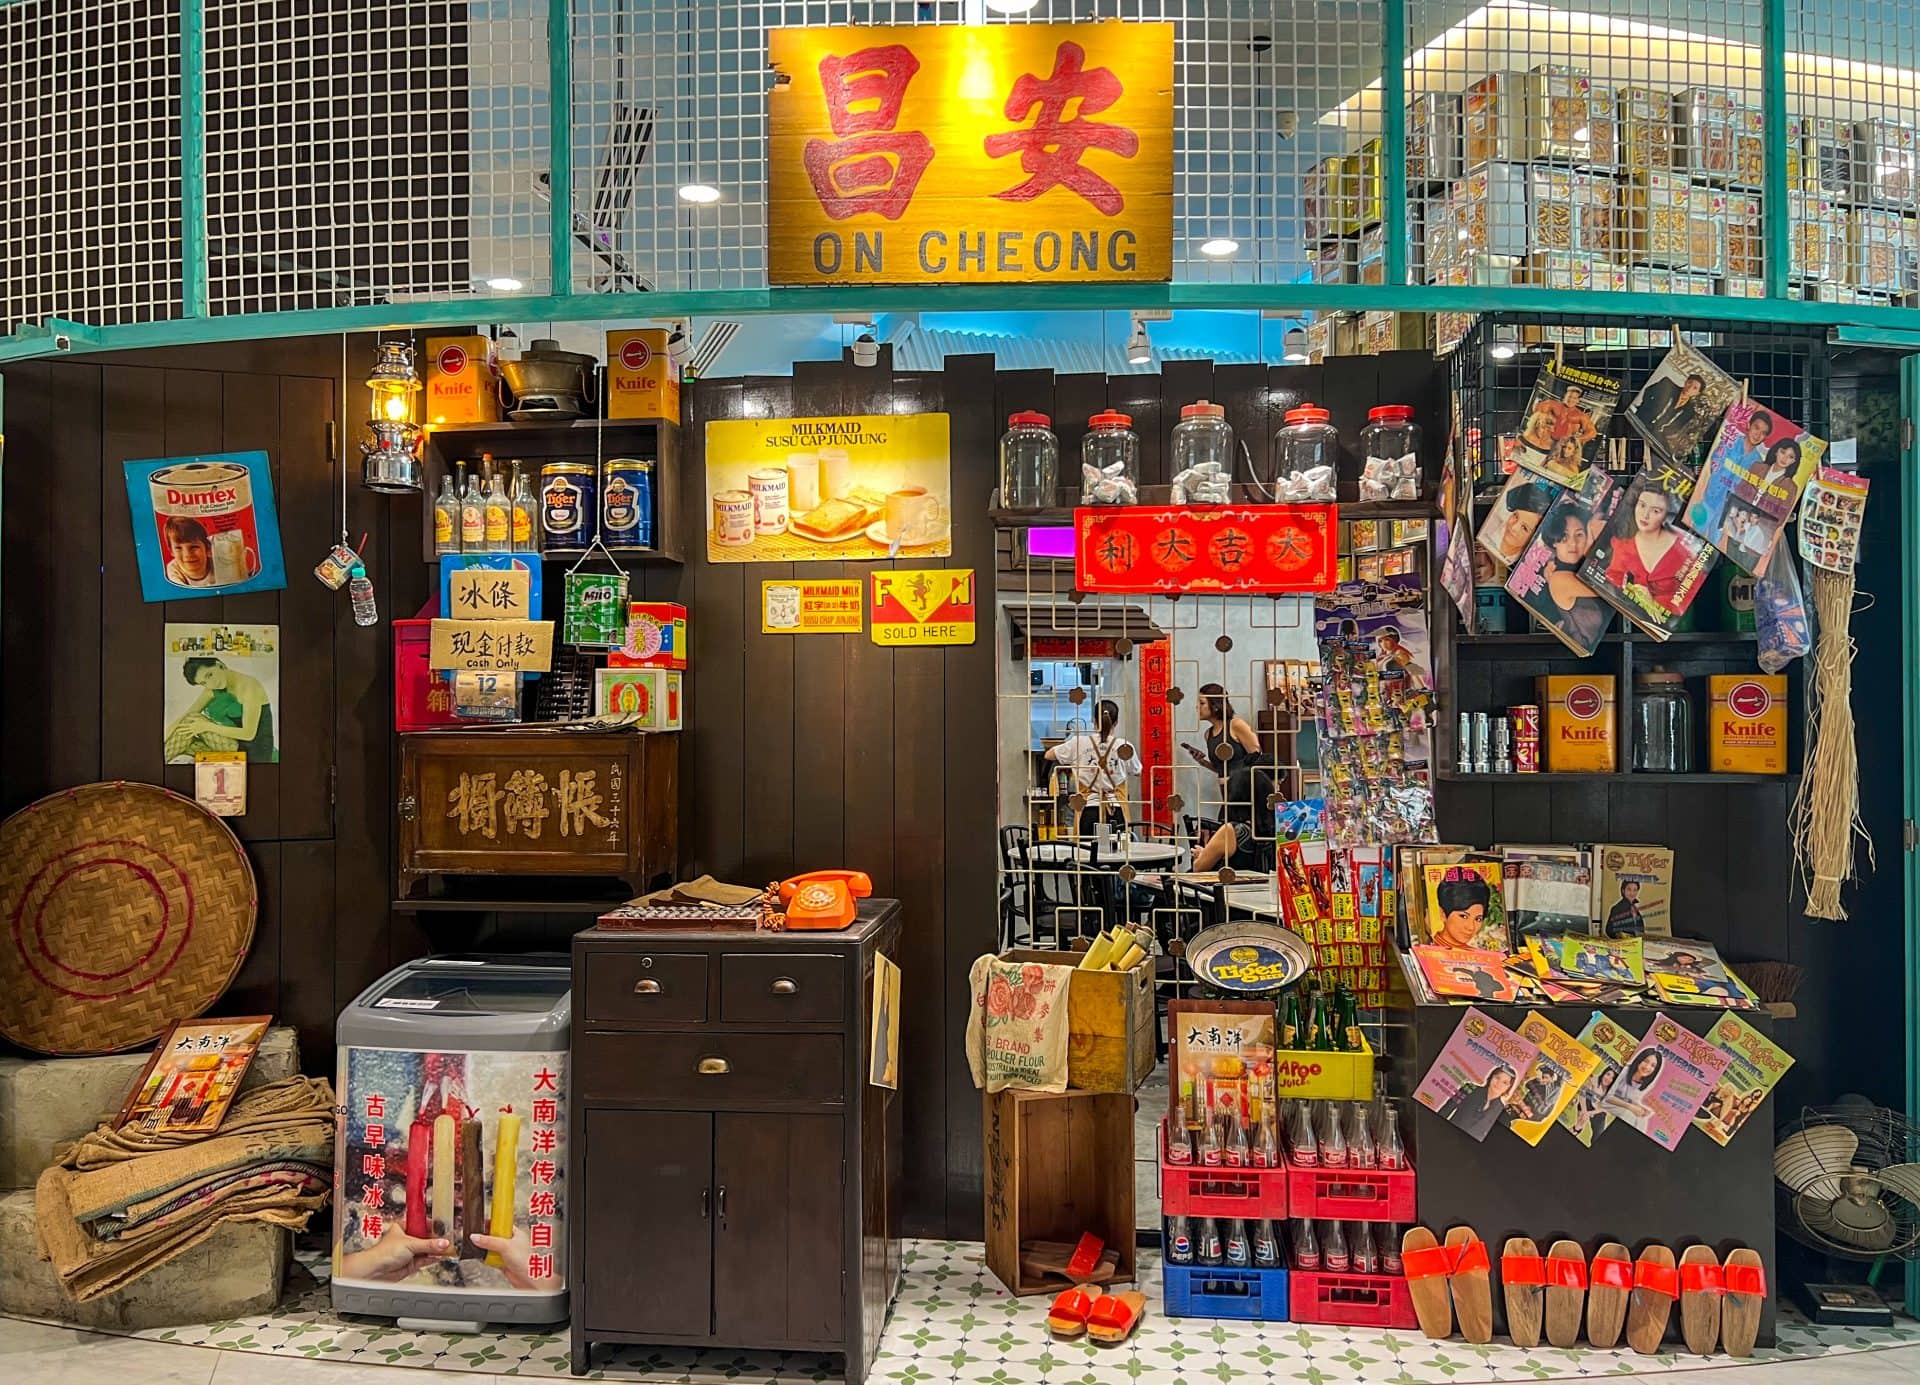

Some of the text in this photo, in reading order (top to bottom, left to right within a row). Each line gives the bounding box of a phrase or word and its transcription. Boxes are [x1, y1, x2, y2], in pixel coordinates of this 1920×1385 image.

[813, 230, 1137, 273] ON CHEONG
[434, 382, 473, 395] Knife
[616, 376, 657, 390] Knife
[791, 422, 862, 434] MILKMAID
[765, 433, 887, 448] SUSU CAP JUNJUNG
[751, 482, 786, 492] MILKMAID
[167, 487, 237, 506] Dumex
[547, 492, 576, 508] Tiger
[607, 493, 633, 507] Tiger
[714, 502, 752, 513] MILKMAID
[458, 578, 519, 610] 冰條
[584, 590, 612, 601] MILO
[803, 586, 859, 596] MILKMAID MILK
[874, 579, 892, 607] F
[884, 625, 957, 641] SOLD HERE
[496, 658, 520, 671] Only
[478, 676, 497, 693] 12
[1561, 725, 1609, 740] Knife
[1723, 721, 1777, 737] Knife
[213, 767, 226, 795] 1
[1625, 852, 1670, 874] Tiger
[1212, 962, 1283, 984] Tiger
[175, 1034, 231, 1050] 大南洋
[995, 1037, 1031, 1055] BRAND
[1186, 1026, 1243, 1052] 大南洋
[1486, 1024, 1532, 1063] Tiger
[1546, 1032, 1593, 1073] Tiger
[1679, 1030, 1727, 1071] Tiger
[1740, 1032, 1785, 1073] Tiger
[987, 1062, 1019, 1074] USTRALIAN
[1018, 1055, 1046, 1068] FLOUR
[1277, 1059, 1323, 1078] APOO
[361, 1094, 387, 1240] 古早味冰棒
[528, 1067, 558, 1280] 大南洋传统自制
